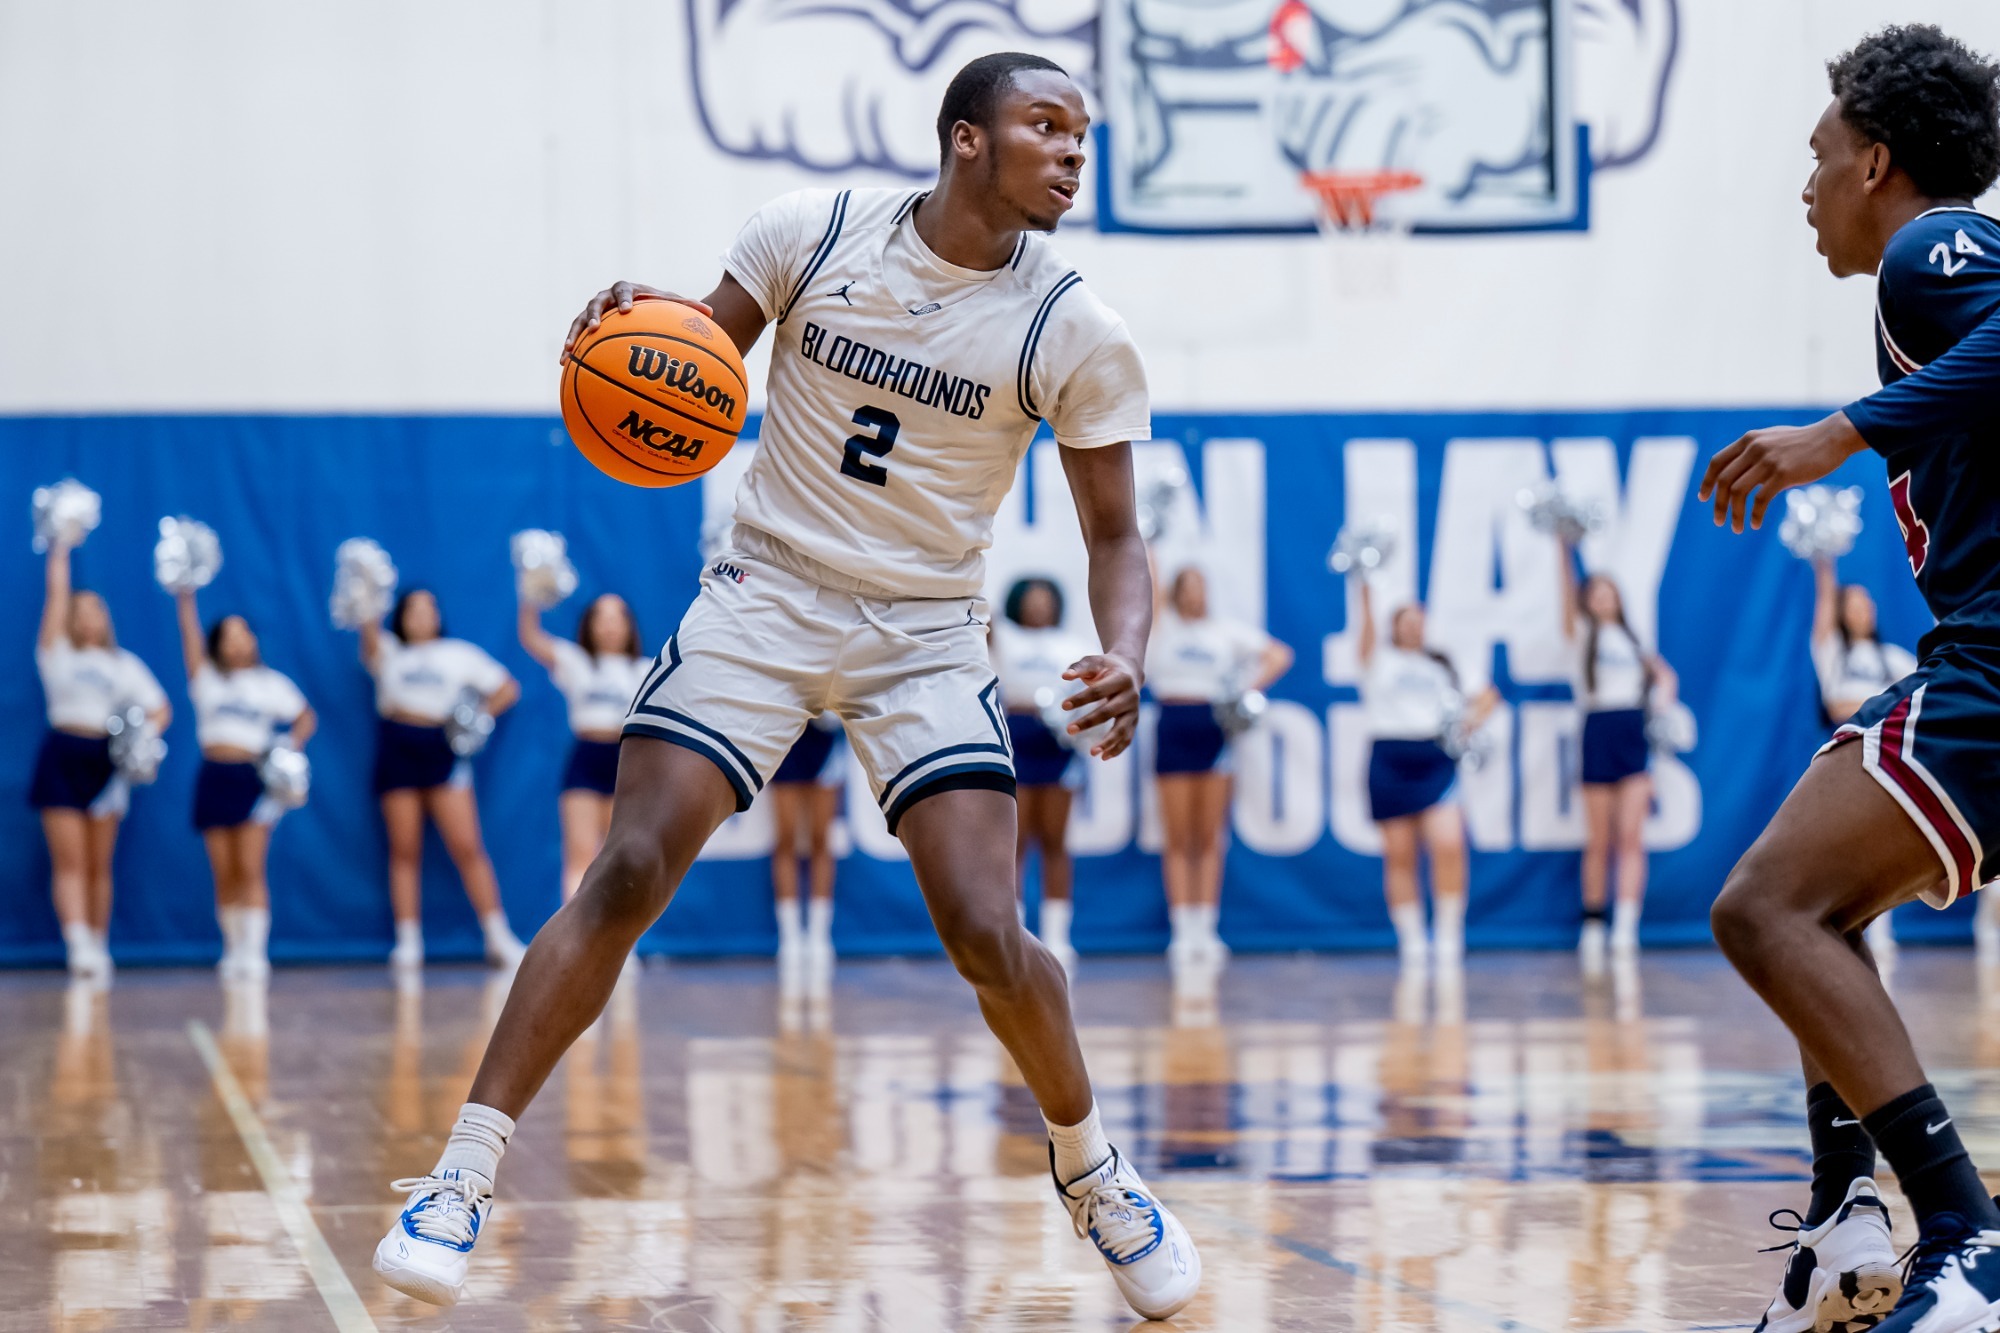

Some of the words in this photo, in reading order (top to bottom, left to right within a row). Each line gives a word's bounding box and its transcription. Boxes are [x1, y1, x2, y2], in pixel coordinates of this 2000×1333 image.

[1928, 228, 1985, 278] 24
[628, 345, 736, 420] Wilson
[801, 322, 991, 420] BLOODHOUNDS
[617, 410, 706, 460] NCAA
[840, 404, 901, 488] 2
[1322, 436, 1699, 687] JAY
